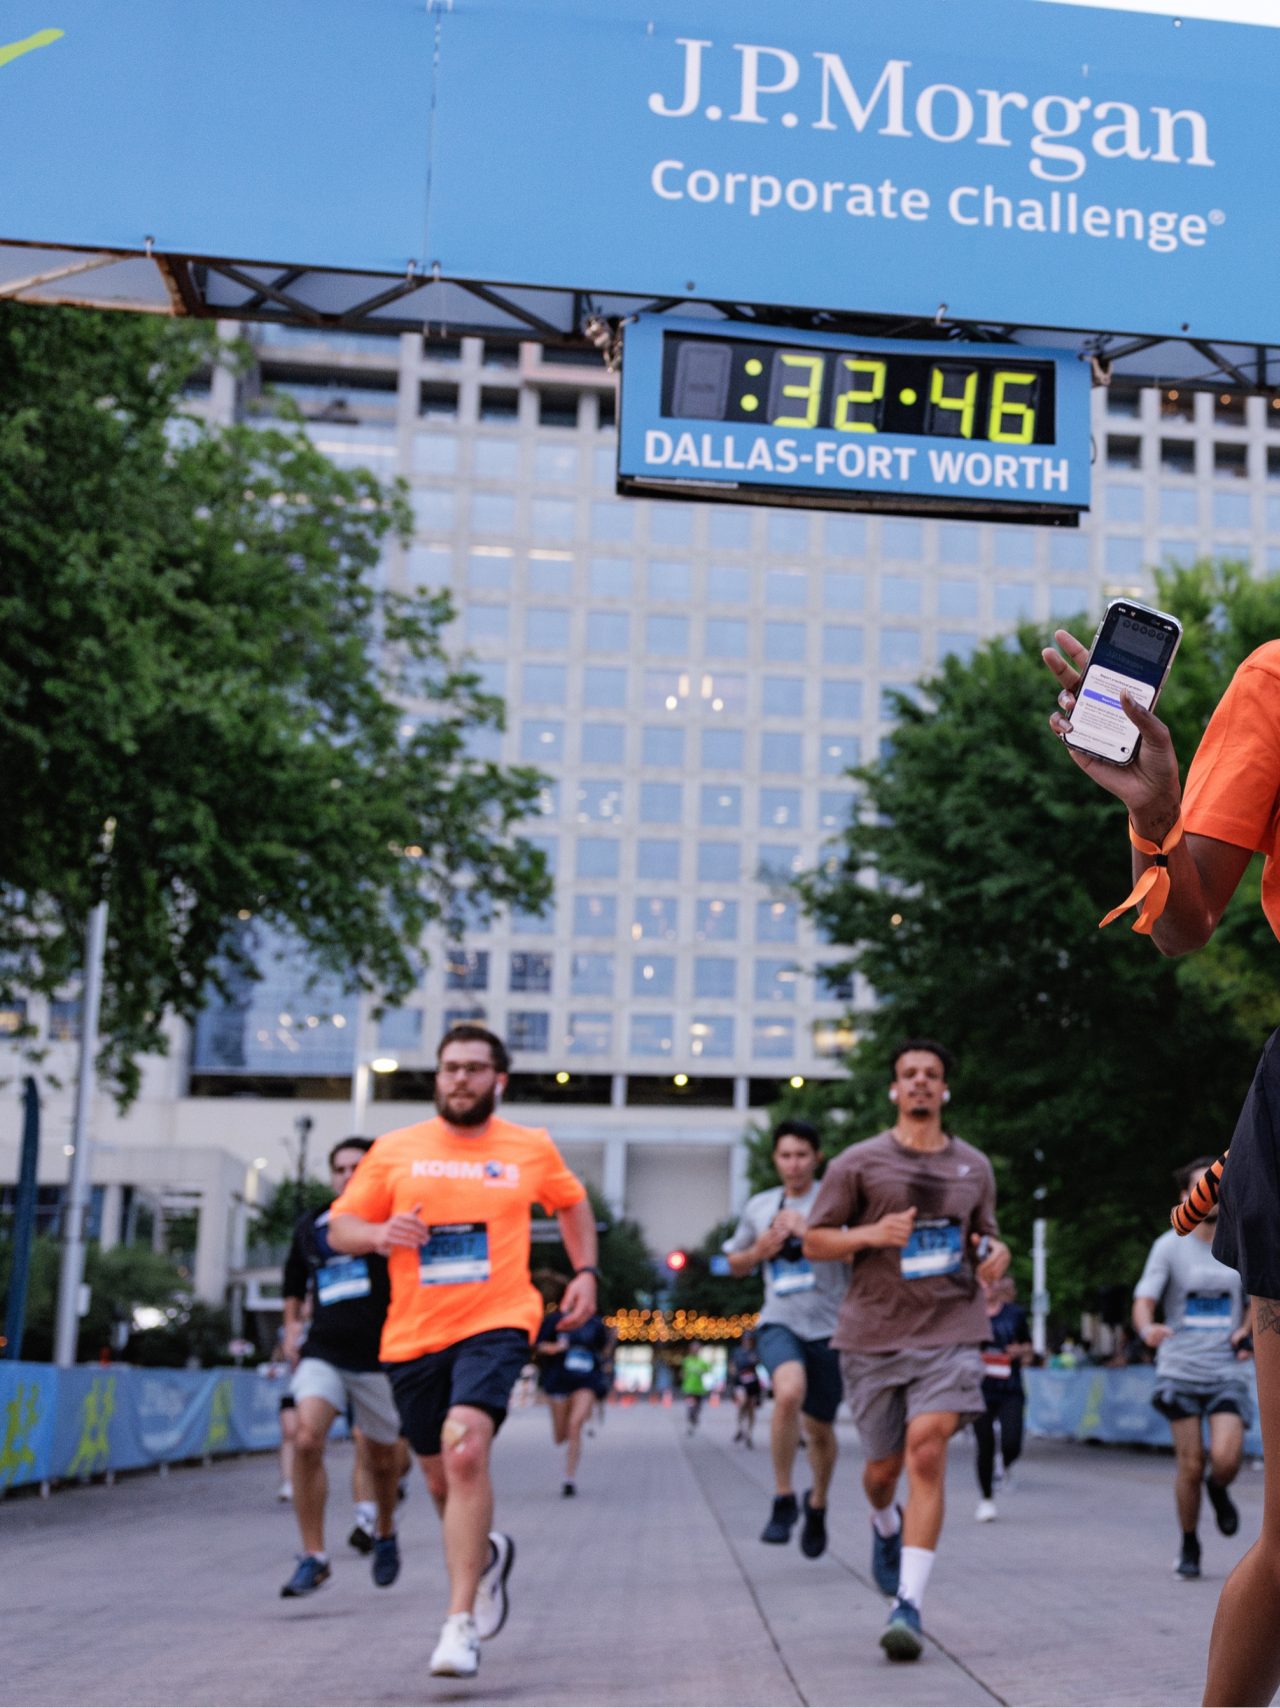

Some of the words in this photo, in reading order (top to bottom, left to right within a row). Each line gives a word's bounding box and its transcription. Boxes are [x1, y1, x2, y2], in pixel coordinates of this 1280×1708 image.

[648, 37, 1216, 182] J.P.Morgan
[651, 160, 931, 221] Corporate
[644, 431, 917, 484] DALLAS-FORT
[929, 449, 1069, 491] WORTH
